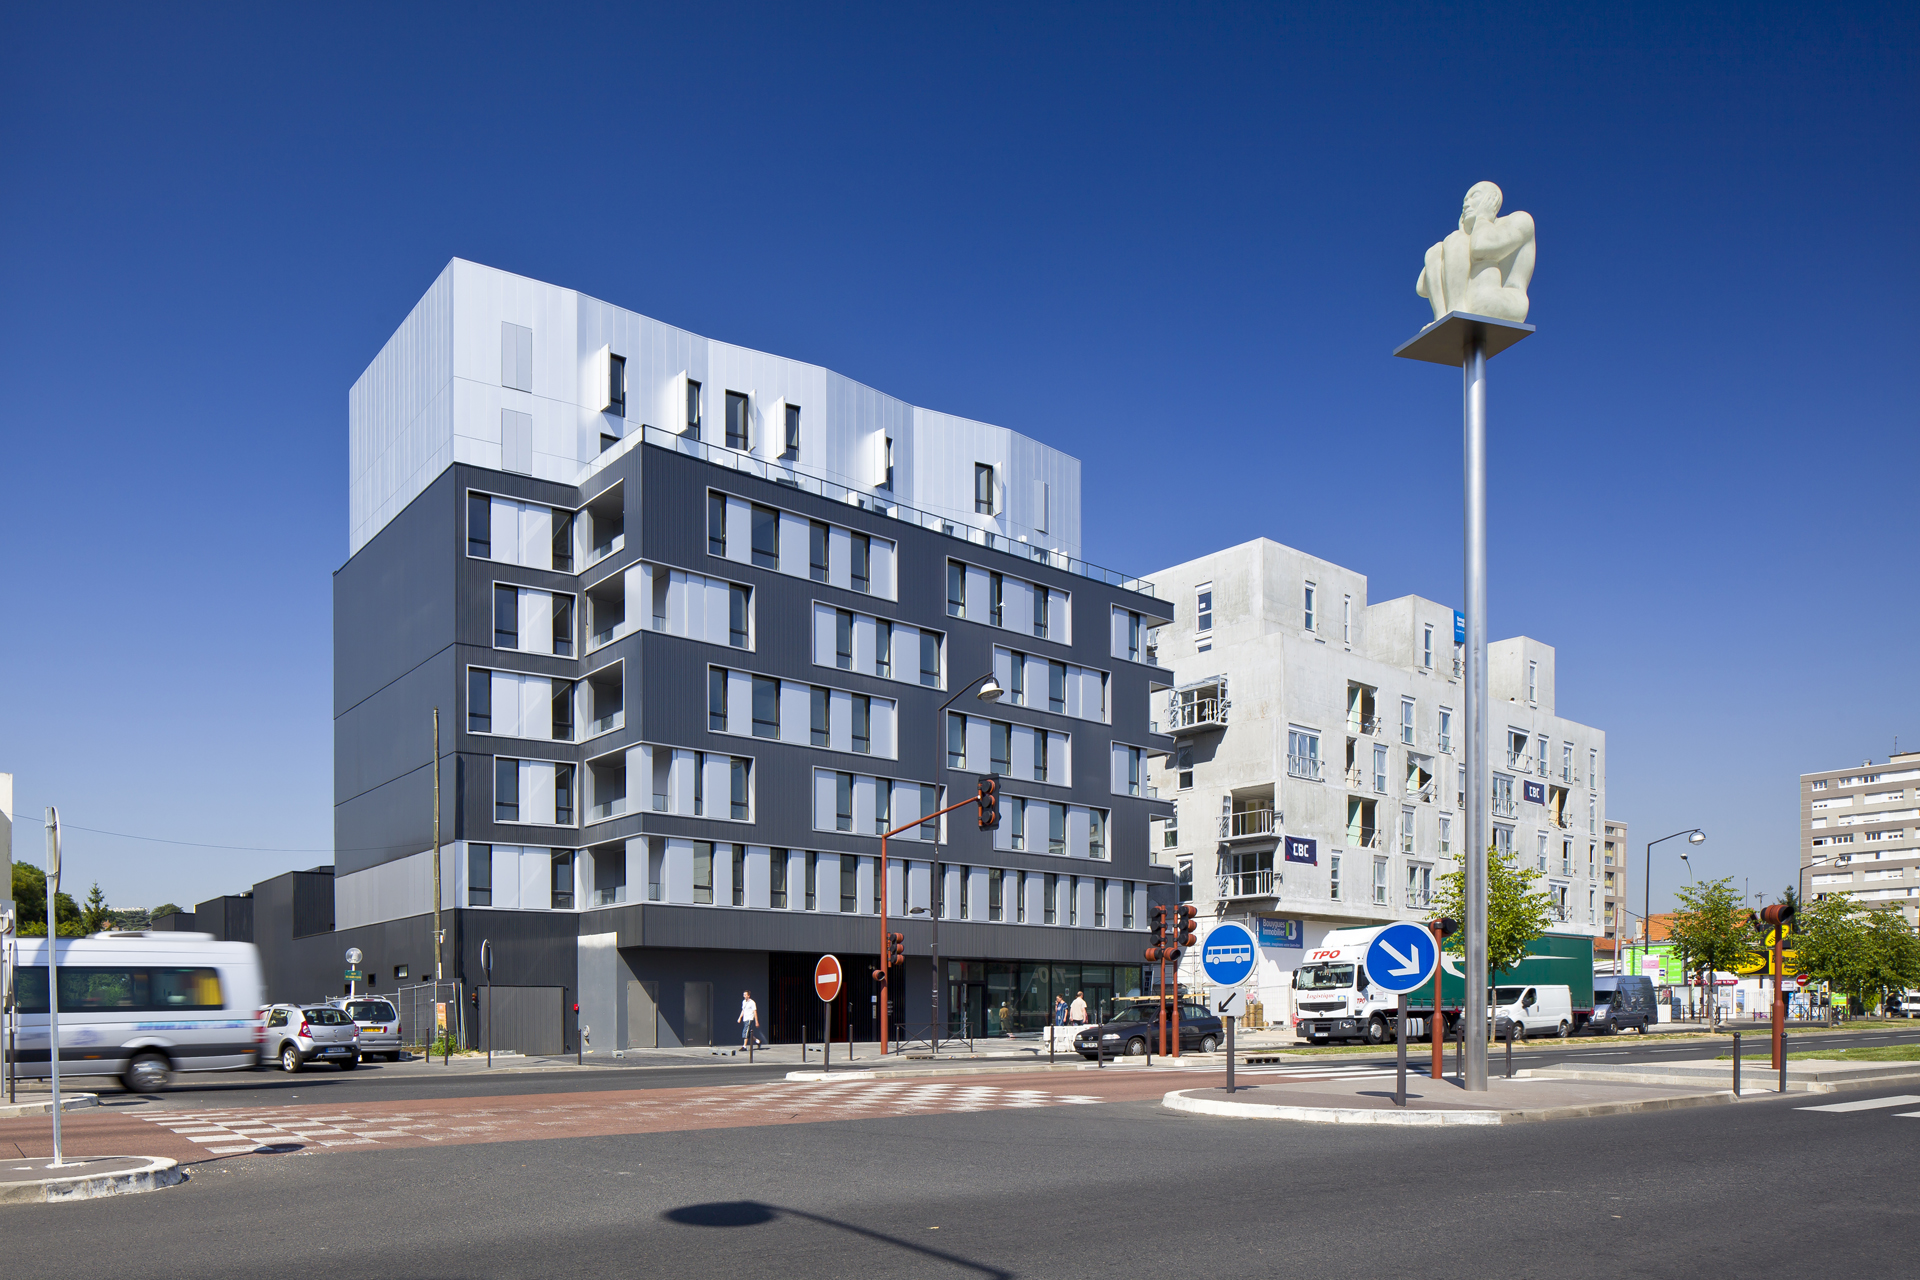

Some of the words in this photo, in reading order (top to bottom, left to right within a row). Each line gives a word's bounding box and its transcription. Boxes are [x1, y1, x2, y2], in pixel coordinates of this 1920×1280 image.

[1529, 786, 1540, 798] CBC
[1293, 843, 1309, 857] CBC
[1262, 919, 1286, 929] Bouygues
[1262, 928, 1286, 936] Immobilier
[1312, 950, 1341, 960] TPO
